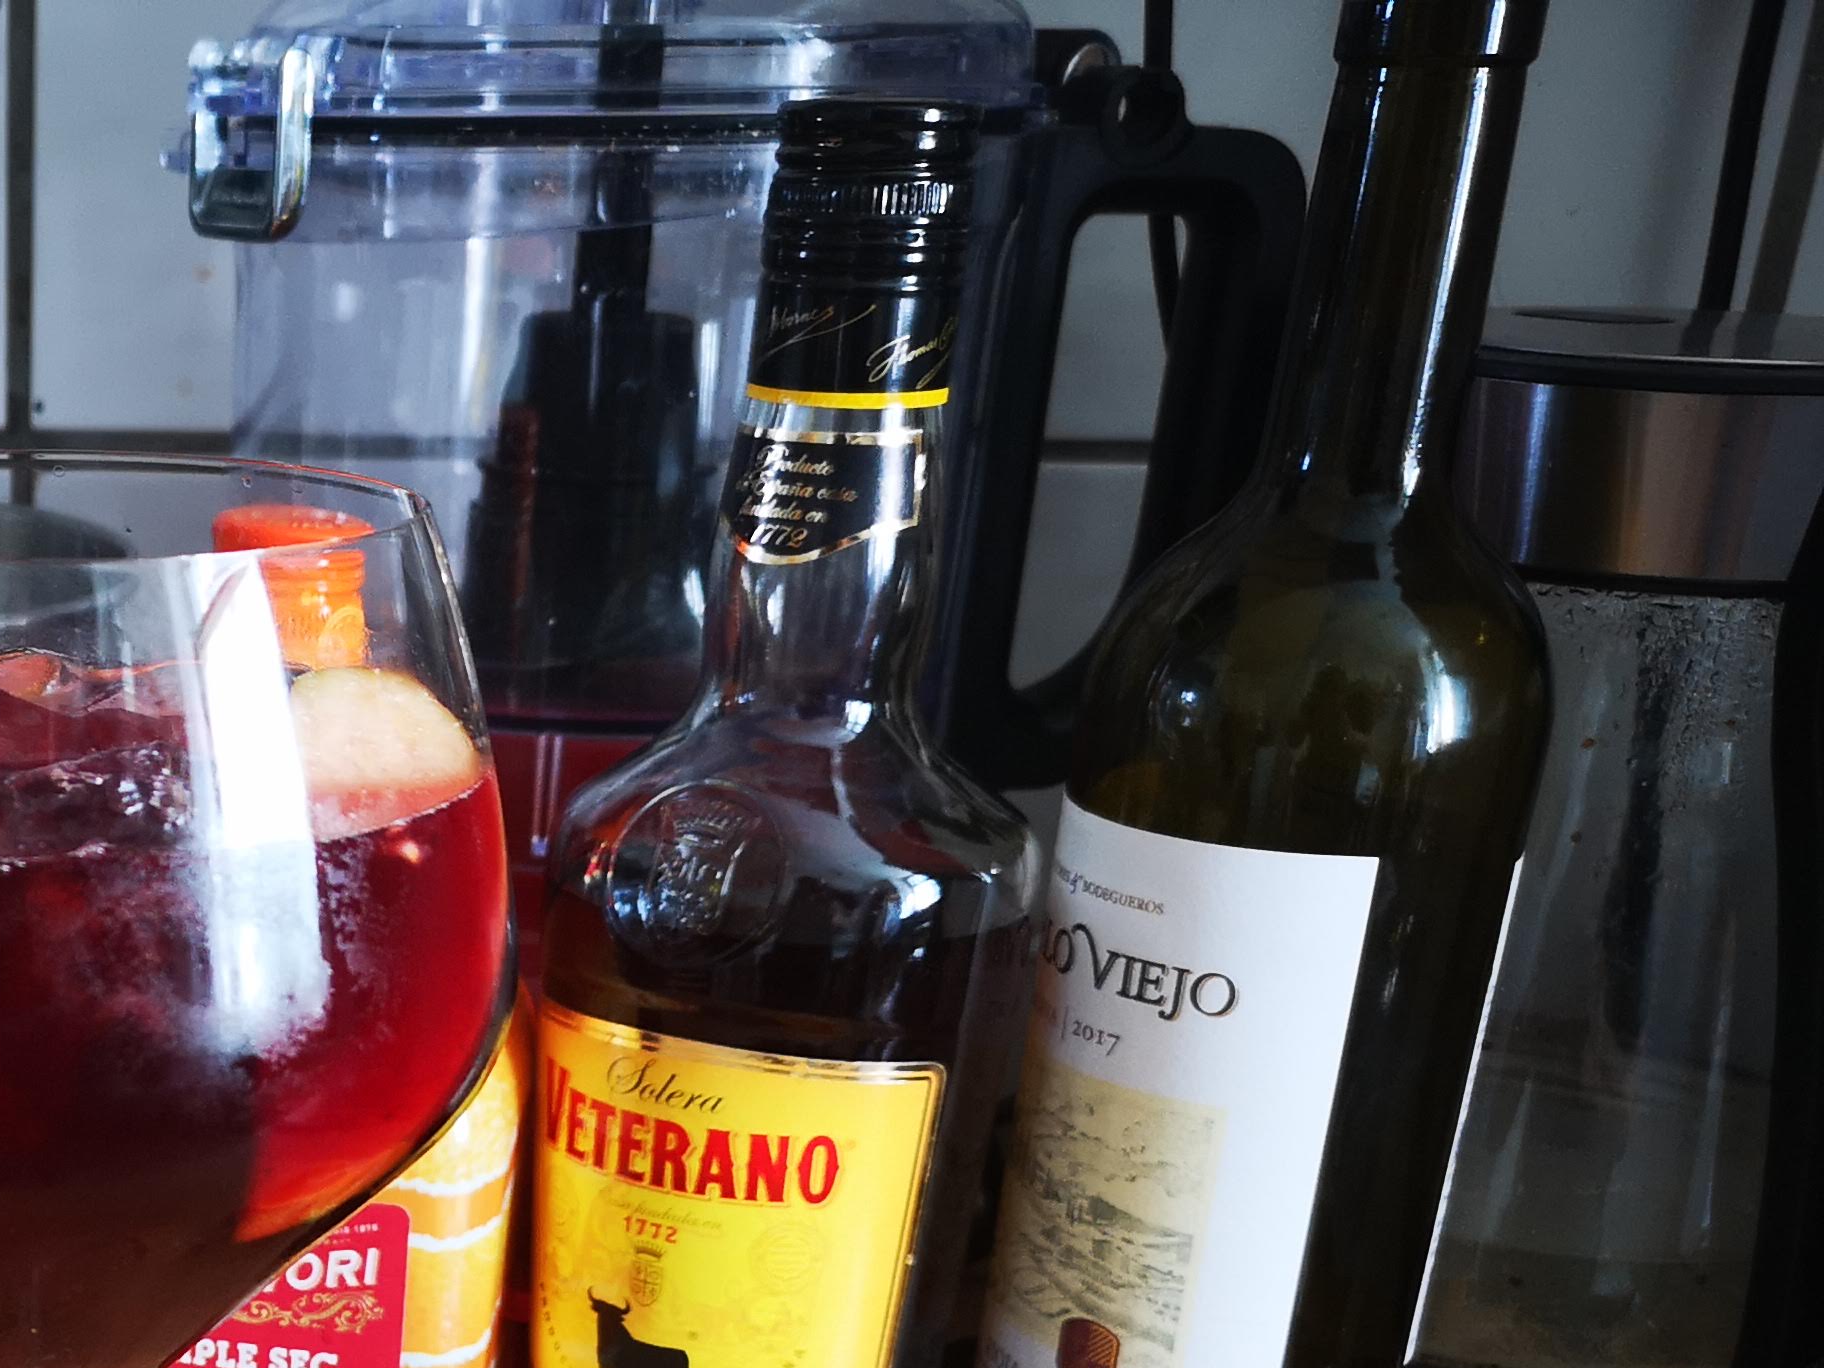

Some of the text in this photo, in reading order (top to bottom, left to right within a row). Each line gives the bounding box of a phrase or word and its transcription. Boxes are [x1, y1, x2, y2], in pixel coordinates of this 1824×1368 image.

[749, 522, 809, 549] 1772
[1072, 1018, 1122, 1057] 2017
[606, 1055, 725, 1115] Solera
[544, 1054, 842, 1206] VETERANO
[623, 1214, 678, 1245] 1772
